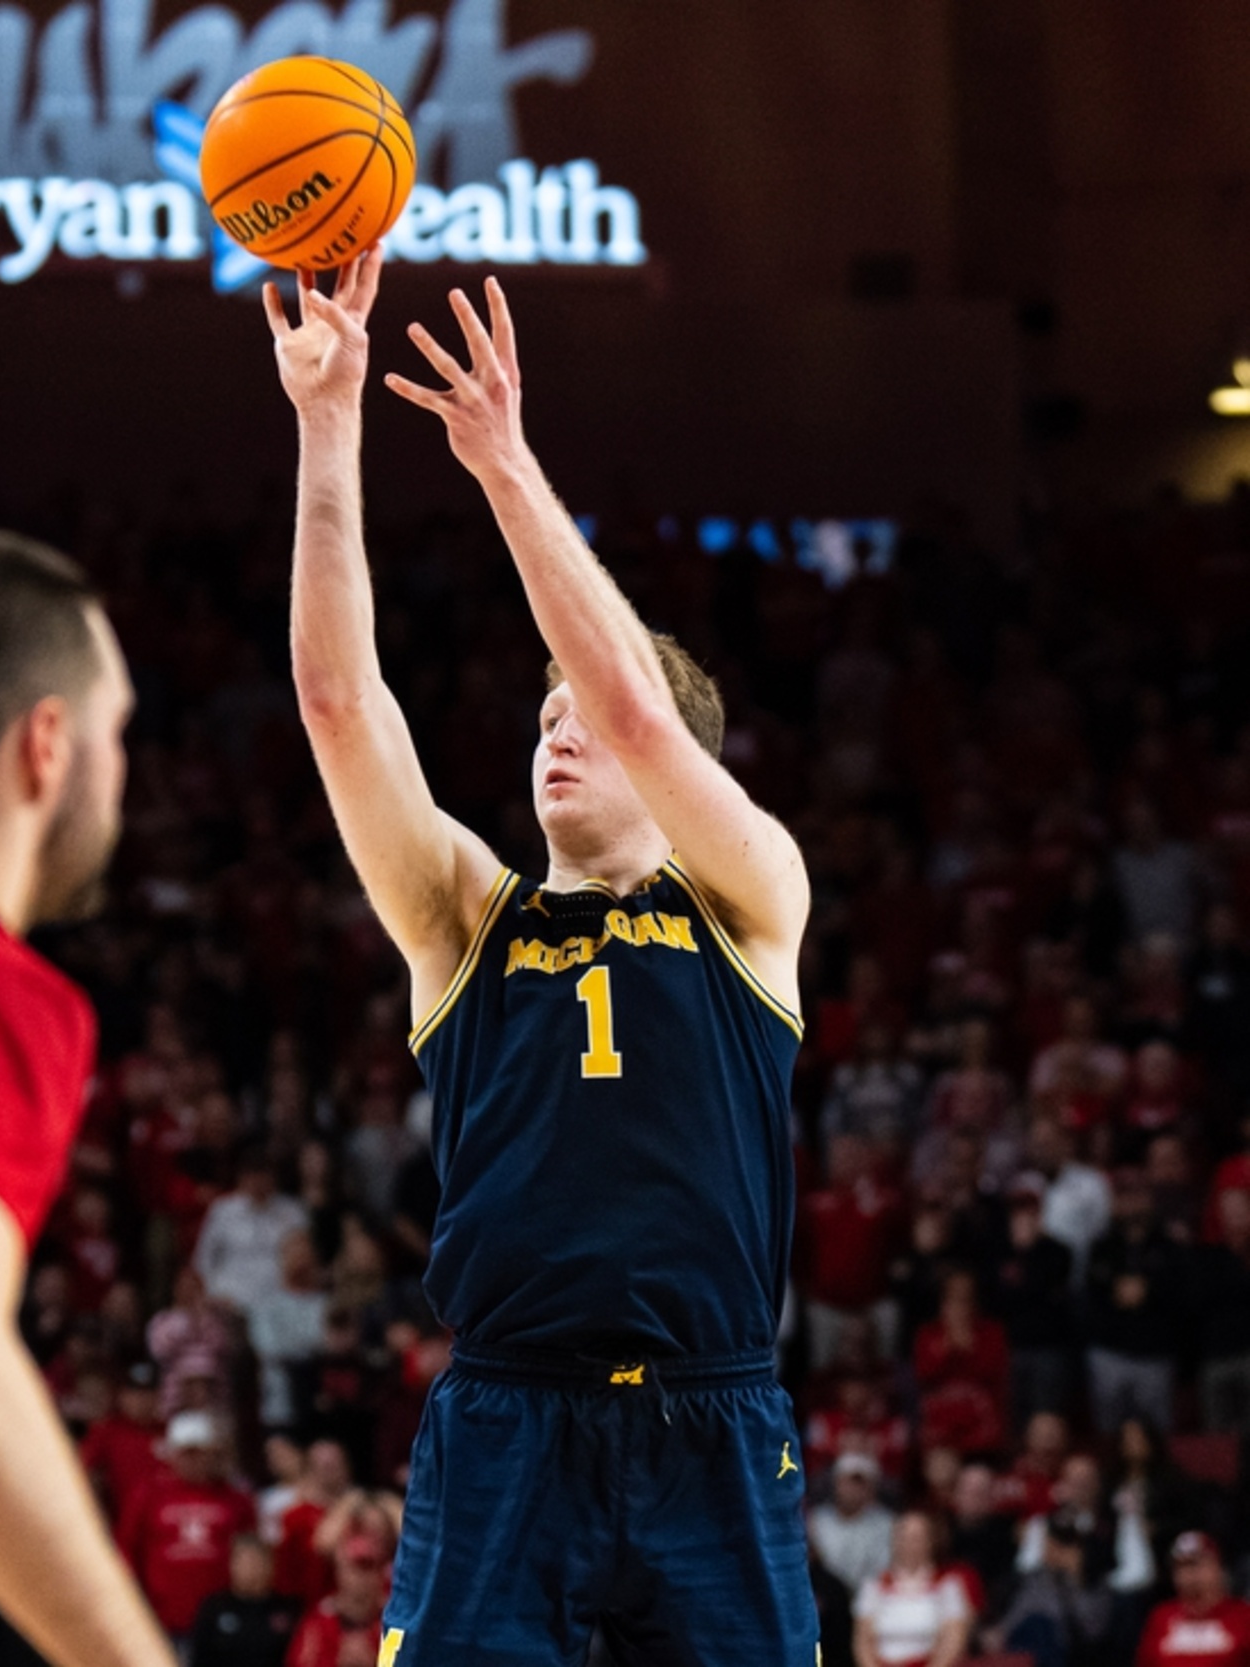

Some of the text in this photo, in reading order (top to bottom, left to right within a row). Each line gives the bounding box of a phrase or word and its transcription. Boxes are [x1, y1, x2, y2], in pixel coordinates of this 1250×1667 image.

[220, 171, 334, 245] Wilson
[380, 157, 648, 265] ealth
[576, 966, 622, 1078] 1
